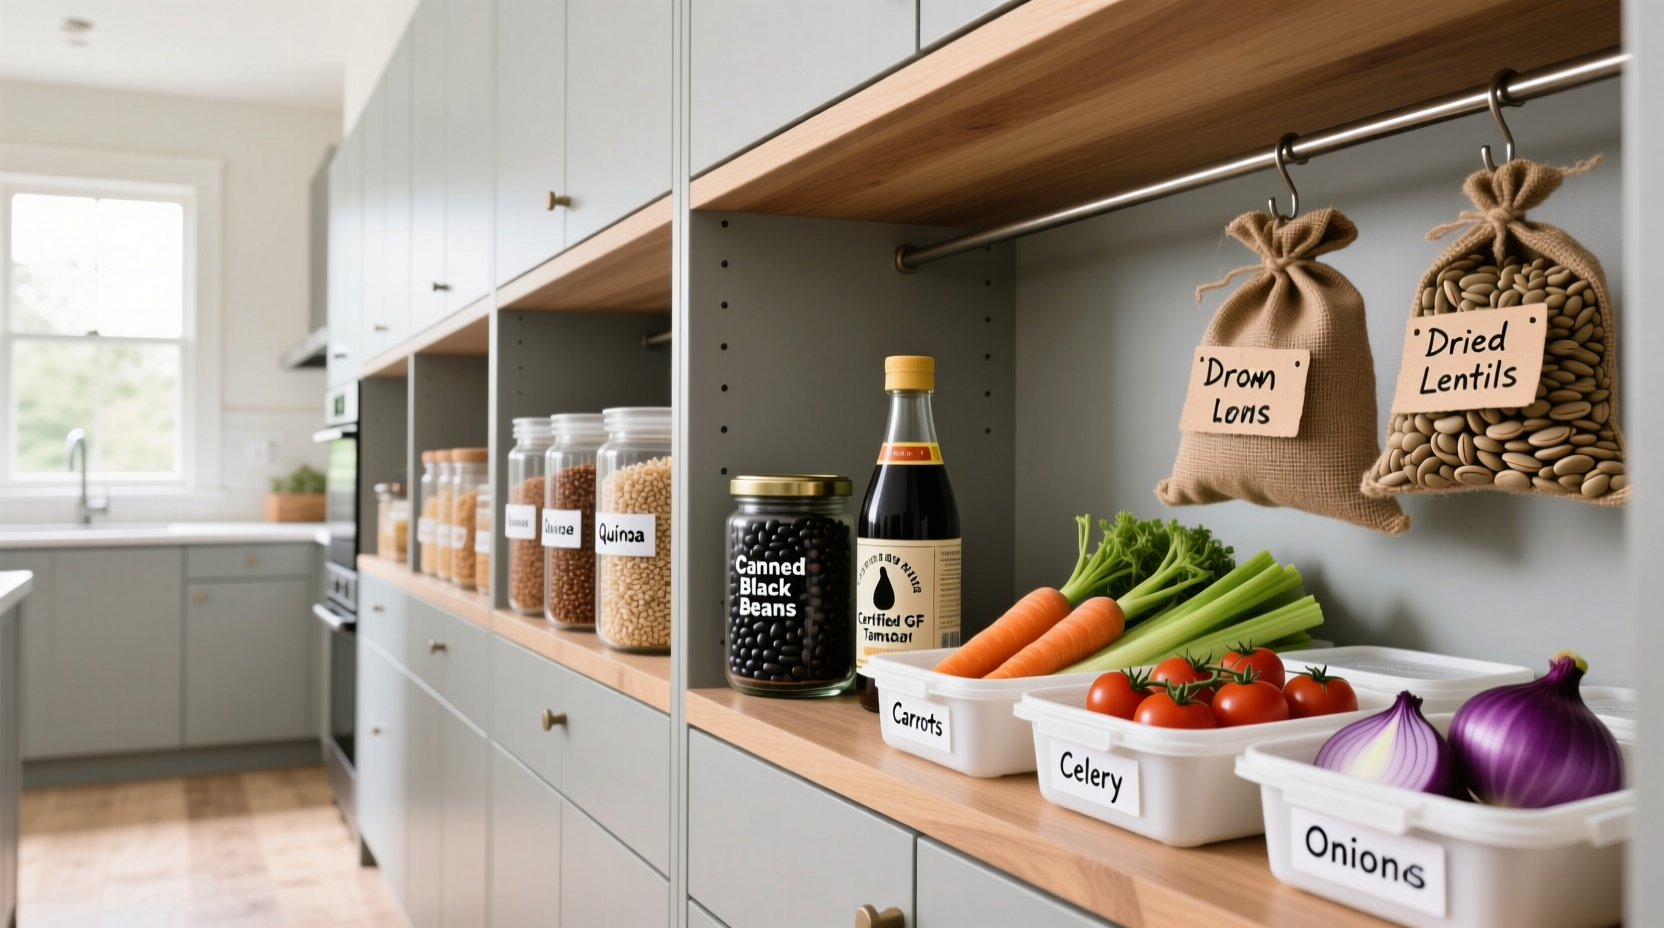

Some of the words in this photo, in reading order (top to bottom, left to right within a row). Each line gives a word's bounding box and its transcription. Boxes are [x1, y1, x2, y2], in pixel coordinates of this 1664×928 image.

[1425, 320, 1508, 357] Dried
[1420, 359, 1517, 395] Lentils
[735, 554, 806, 576] Canned
[740, 577, 792, 597] Black
[739, 597, 797, 617] Beans
[904, 614, 925, 628] GF
[892, 701, 943, 737] Carrots
[1060, 751, 1123, 804] Celery
[1305, 825, 1425, 889] Onions
